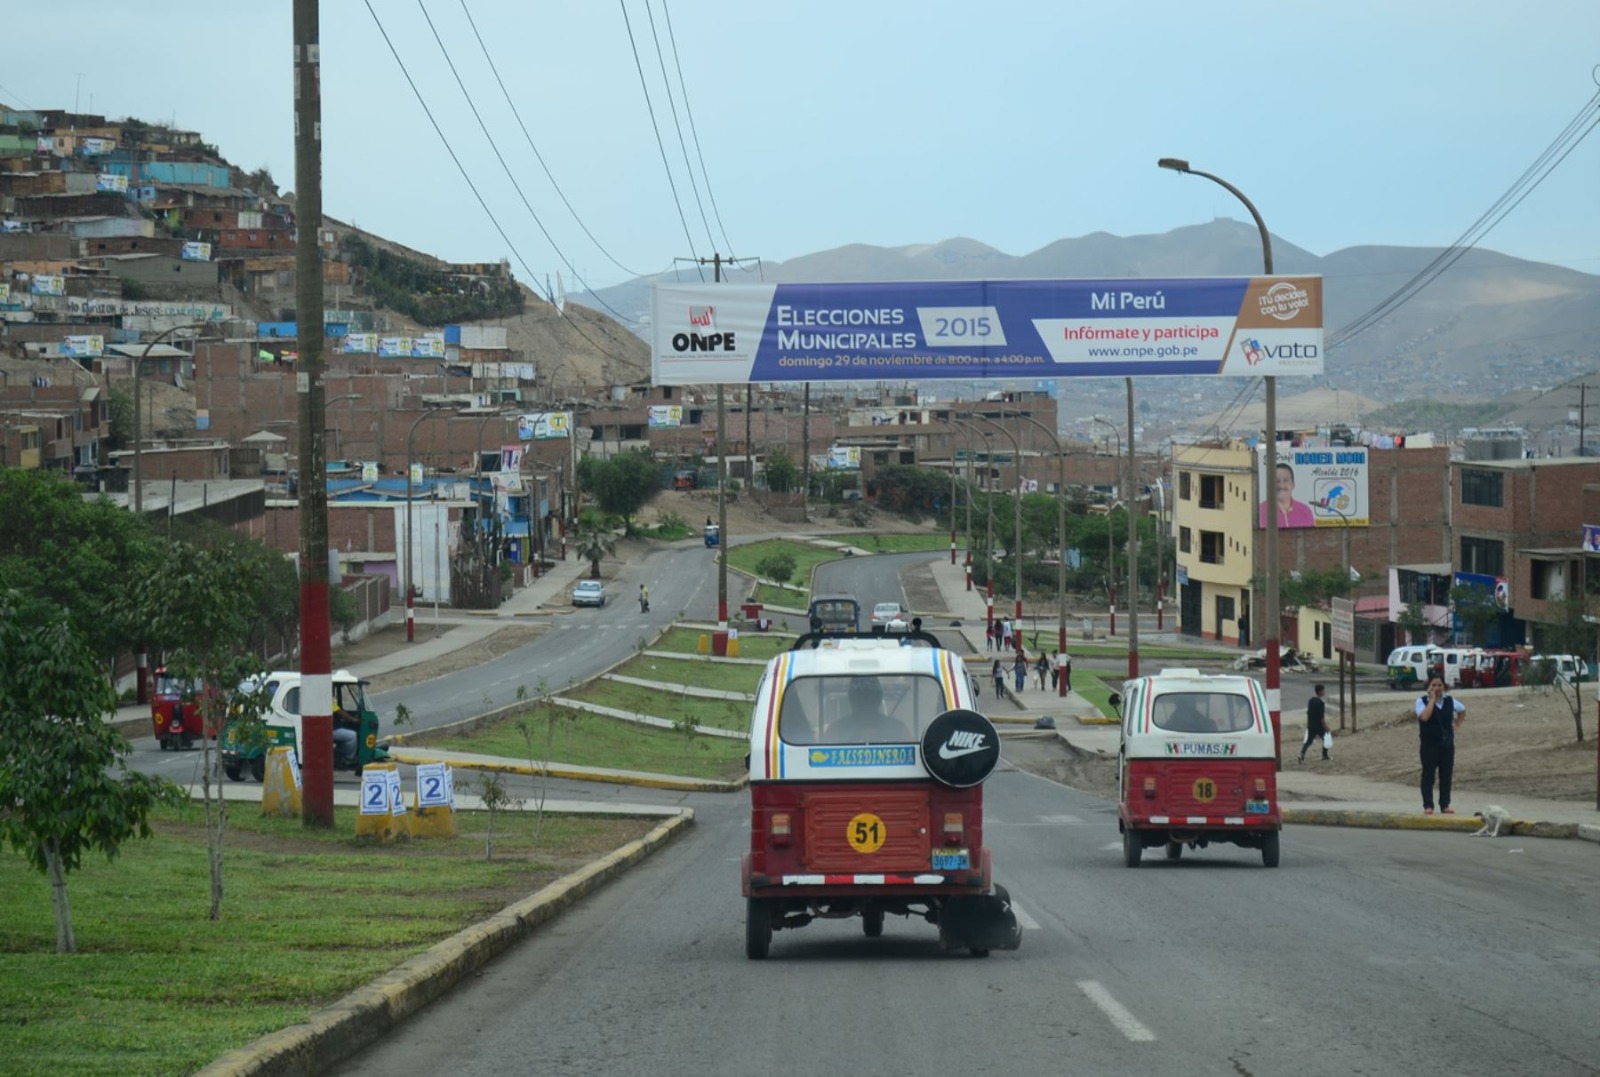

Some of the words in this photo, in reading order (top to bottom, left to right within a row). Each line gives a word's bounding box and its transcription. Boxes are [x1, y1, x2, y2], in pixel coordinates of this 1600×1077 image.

[1091, 292, 1115, 310] Mi
[1120, 291, 1165, 310] Perú
[777, 305, 904, 326] ELECCIONES
[935, 317, 992, 337] 2015
[1064, 326, 1139, 340] Infórmate
[1142, 328, 1151, 341] y
[1154, 325, 1219, 341] participa
[672, 332, 736, 352] ONPE
[778, 329, 916, 350] MUNICIPALES
[1088, 345, 1198, 358] www.onpe.gob.pe
[1263, 342, 1318, 359] voto
[778, 355, 833, 368] domingo
[834, 355, 850, 366] 29
[852, 355, 867, 366] de
[869, 354, 932, 366] noviembre
[934, 356, 947, 365] de
[948, 730, 985, 748] NIKE
[1184, 743, 1219, 754] PUMAS
[368, 784, 383, 806] 2
[425, 777, 442, 798] 2
[1197, 782, 1213, 798] 18
[855, 822, 879, 844] 51
